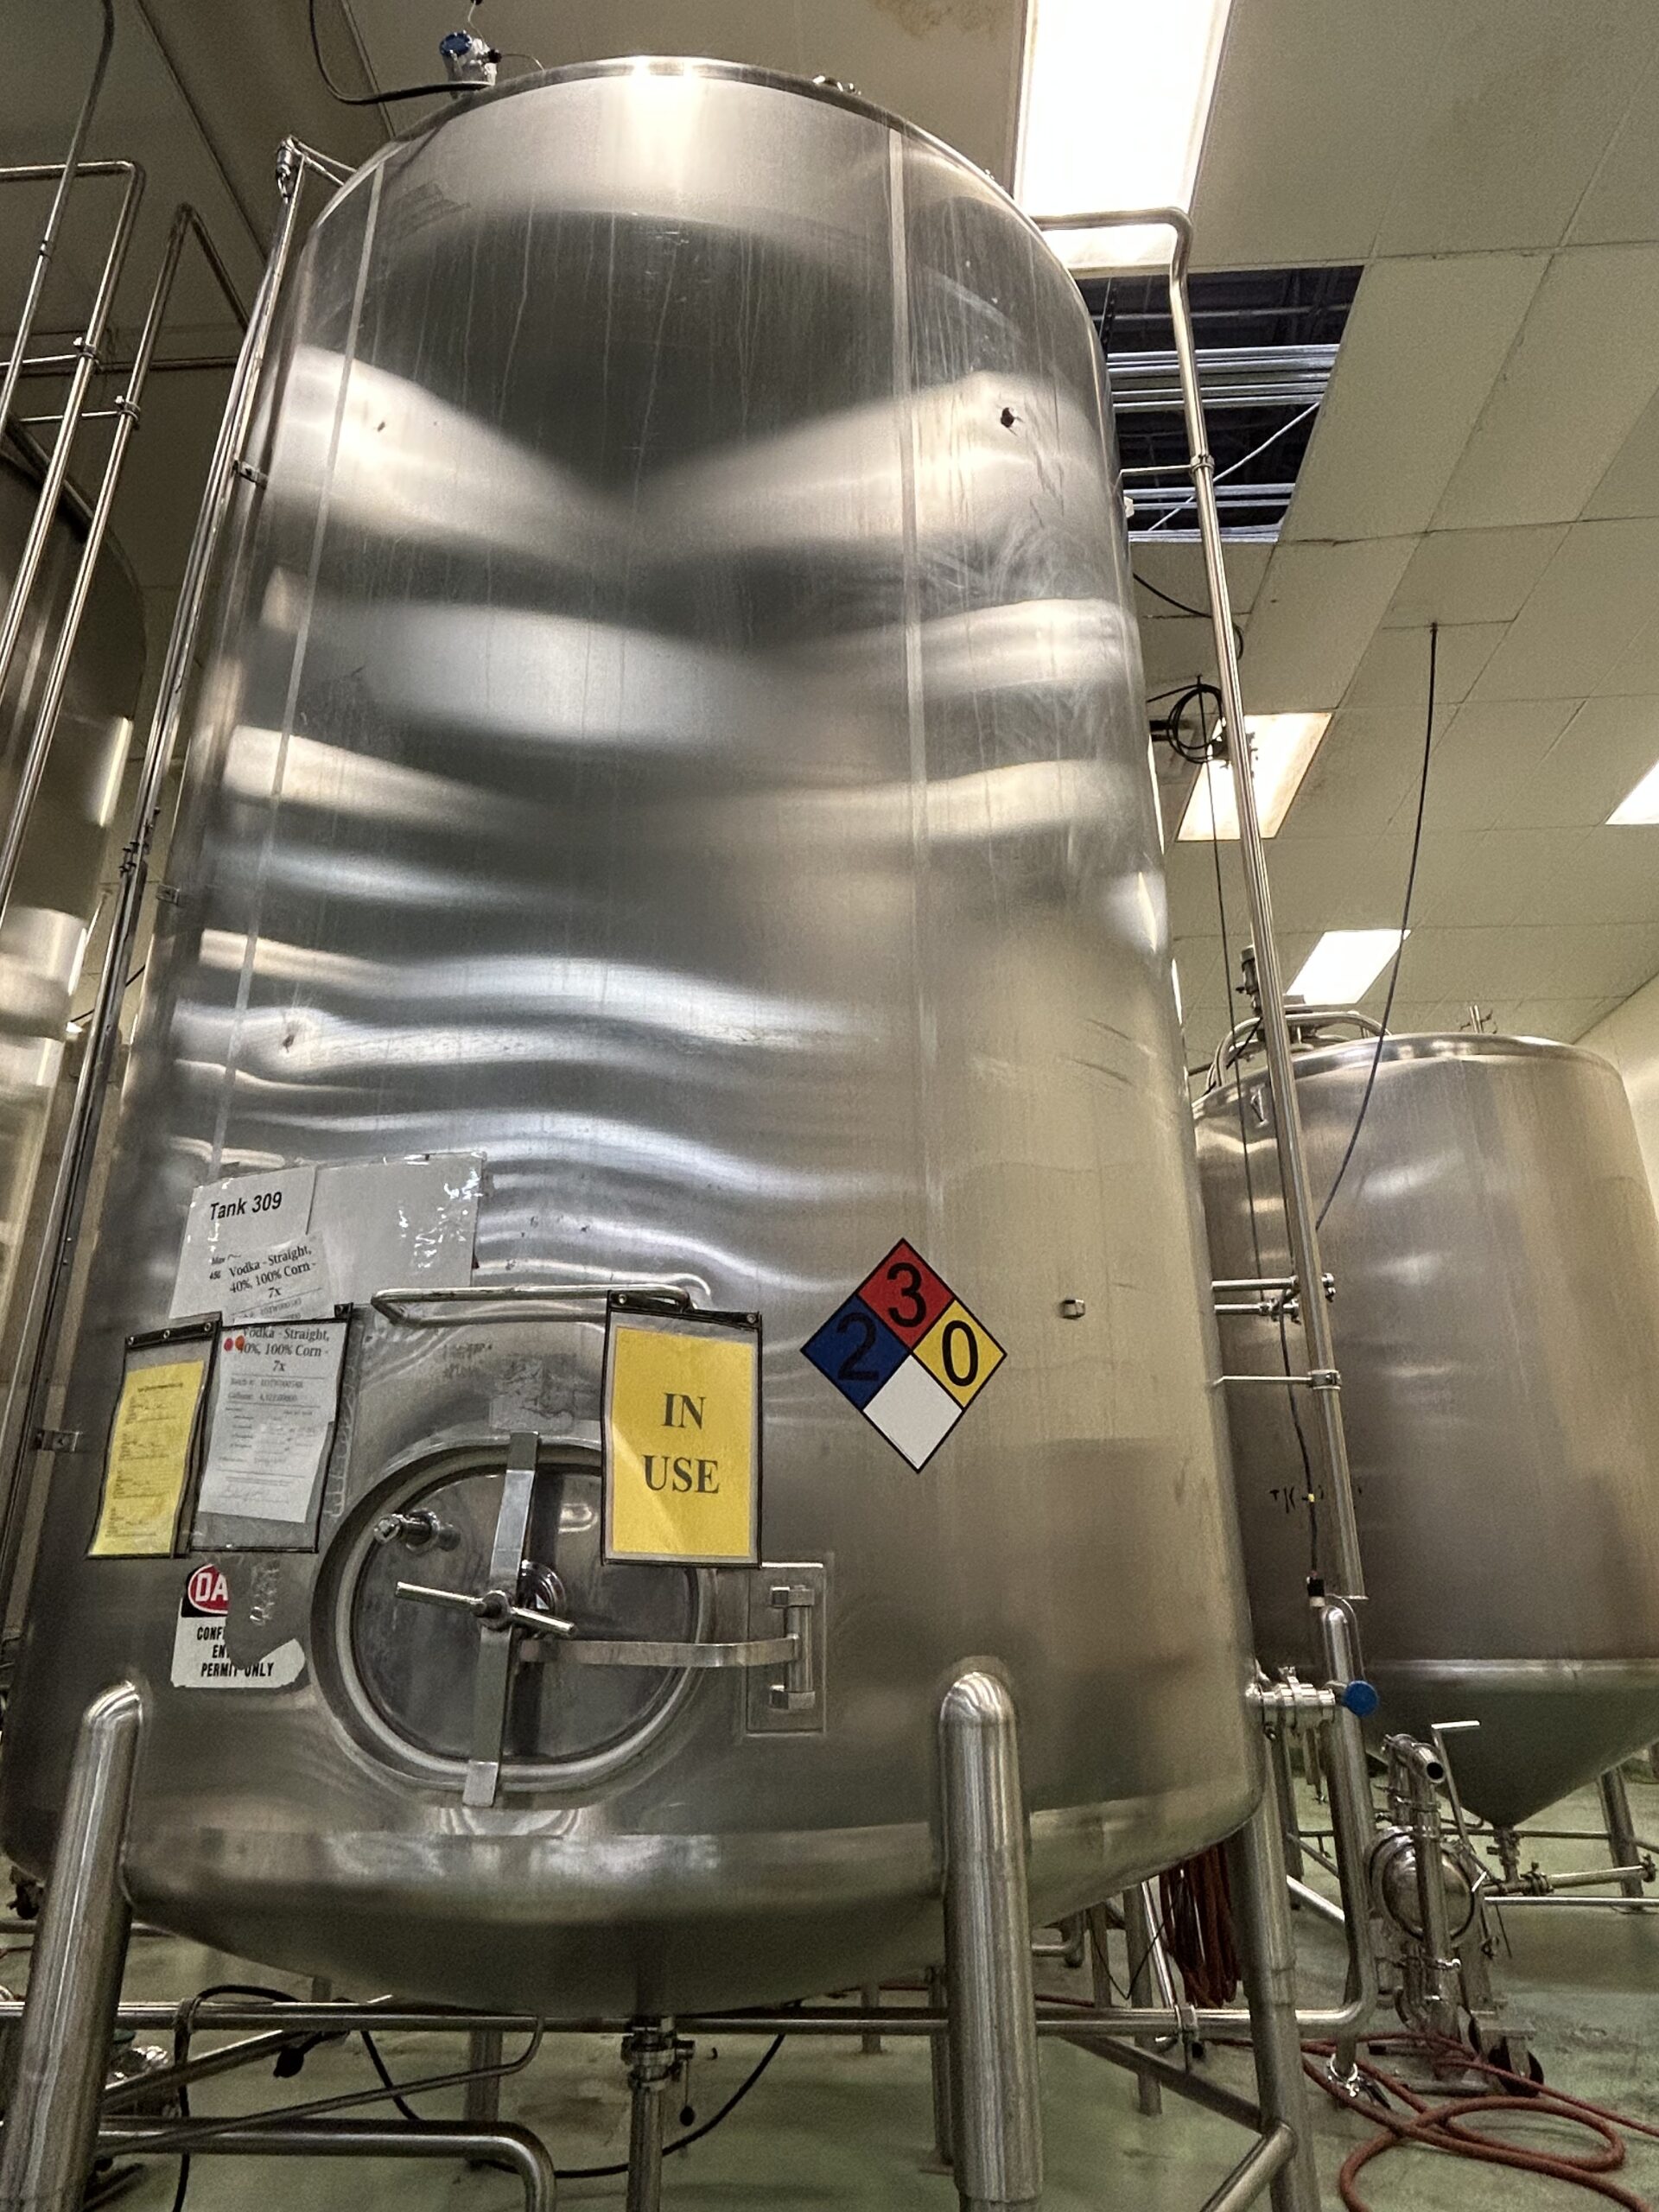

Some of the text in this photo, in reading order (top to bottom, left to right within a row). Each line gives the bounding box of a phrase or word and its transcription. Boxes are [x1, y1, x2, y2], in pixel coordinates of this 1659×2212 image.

[210, 1191, 283, 1220] Tank 309
[228, 1261, 261, 1278] Vodka
[255, 1268, 283, 1286] 100%
[283, 1262, 310, 1277] Corn
[887, 1262, 927, 1328] 3
[265, 1343, 293, 1356] 100%
[295, 1344, 322, 1357] Corn
[836, 1312, 978, 1387] 2 0
[661, 1392, 707, 1431] IN
[643, 1454, 720, 1495] USE
[197, 1626, 225, 1641] CONF
